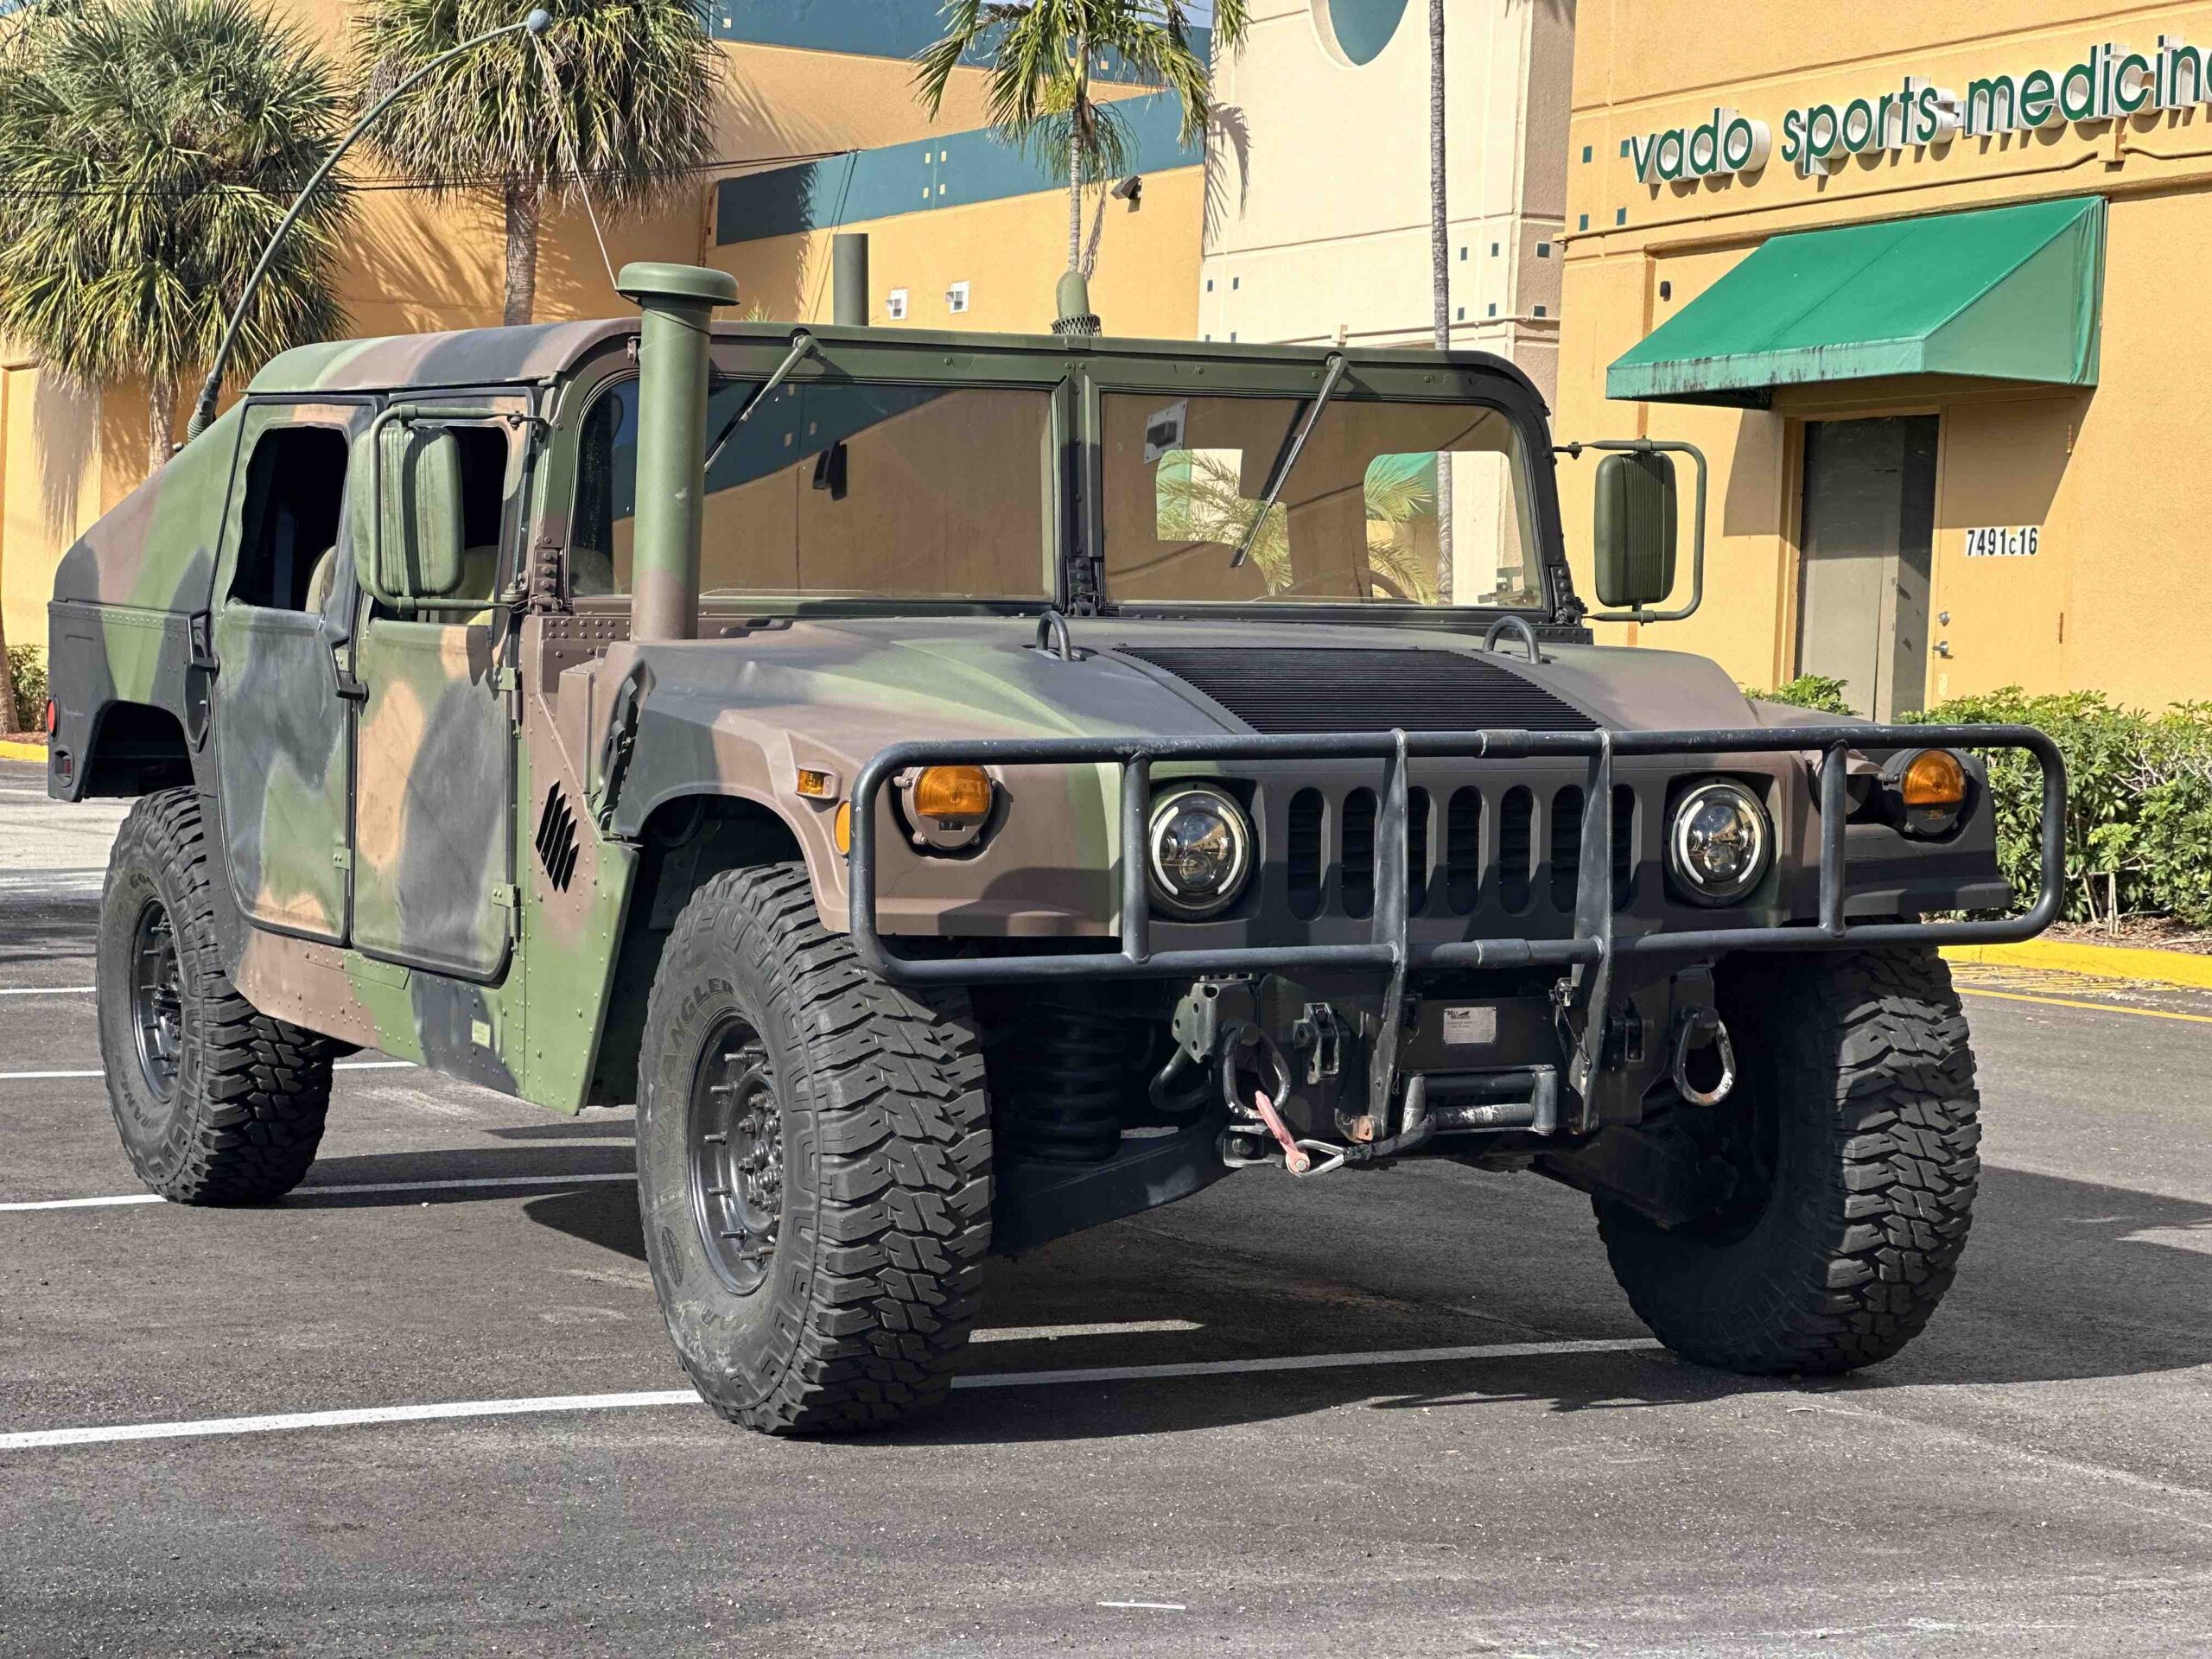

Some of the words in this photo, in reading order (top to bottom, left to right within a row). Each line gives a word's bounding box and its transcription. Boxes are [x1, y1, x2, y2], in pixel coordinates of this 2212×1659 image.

[1631, 107, 1755, 183] vado
[1782, 75, 1939, 175] sports
[1967, 34, 2212, 137] medicin
[1967, 527, 2037, 556] 7491c16
